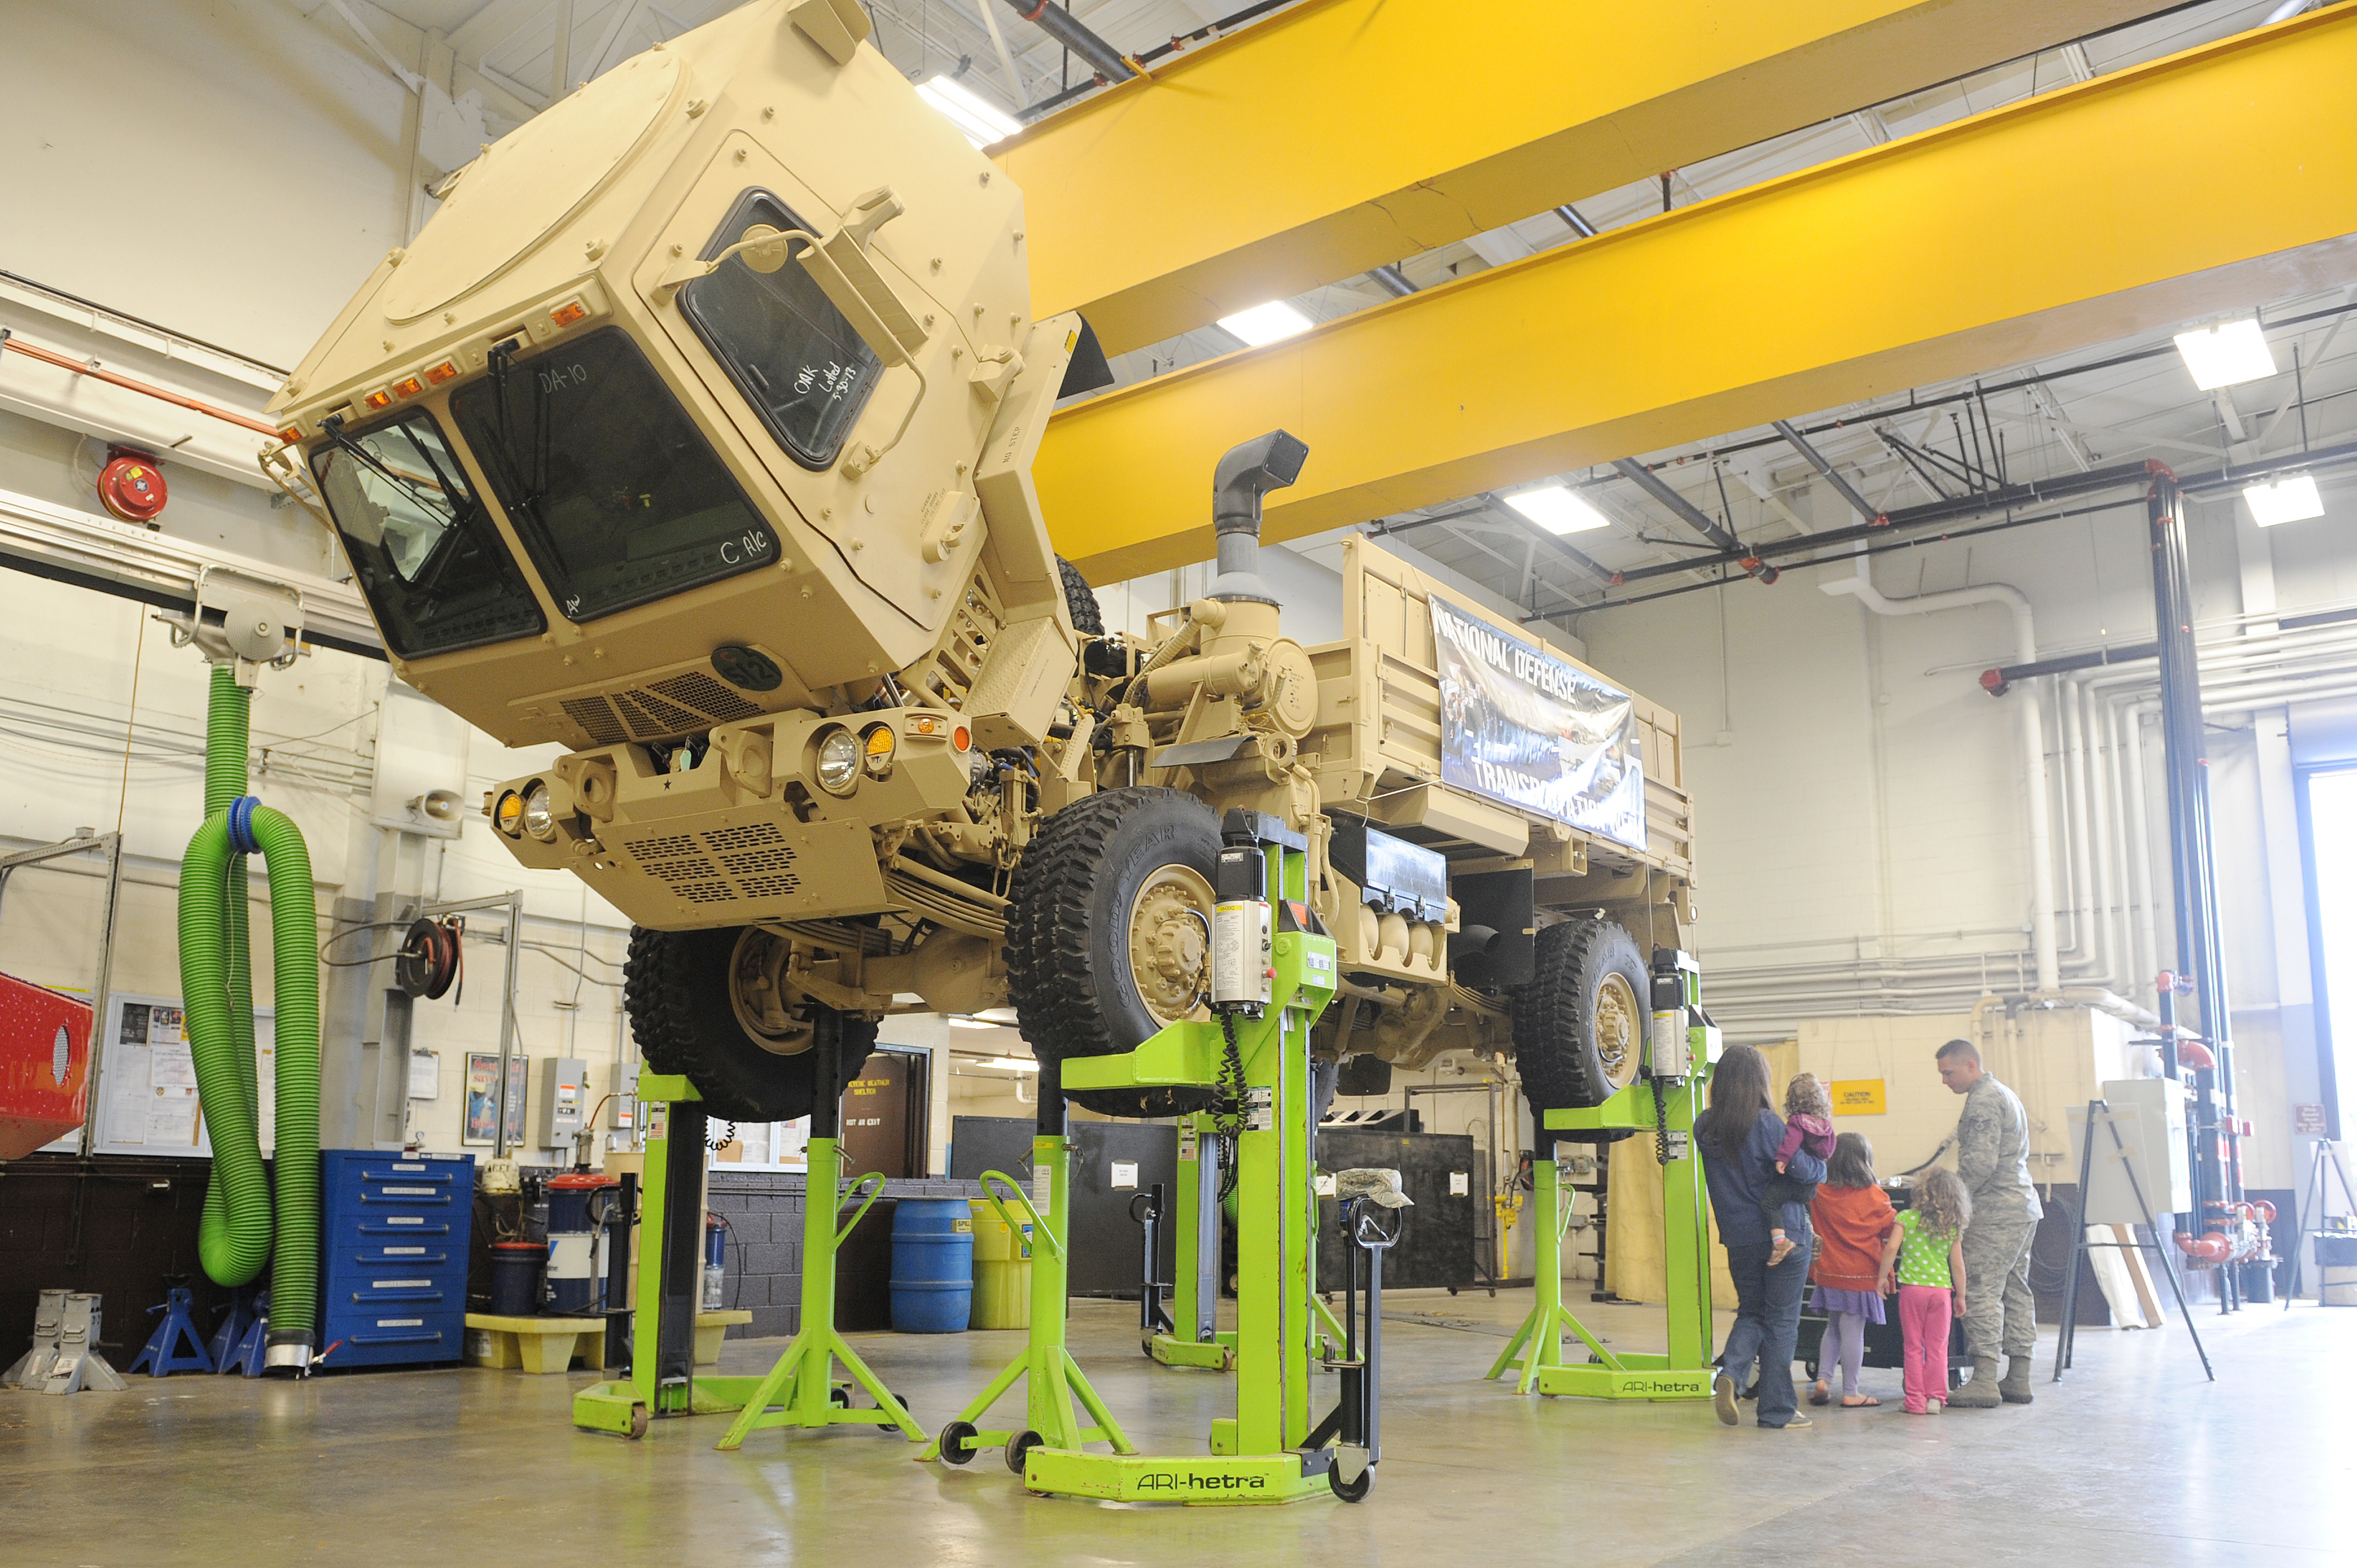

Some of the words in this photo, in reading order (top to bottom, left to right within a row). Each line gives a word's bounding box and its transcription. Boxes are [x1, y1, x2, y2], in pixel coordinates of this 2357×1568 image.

[539, 364, 586, 394] DA-10
[1002, 452, 1012, 463] NO
[1008, 426, 1021, 447] STEP
[1432, 602, 1511, 673] NATIONAL
[1515, 648, 1578, 704] DEFENSE
[866, 1117, 881, 1126] EXIT
[1622, 1381, 1699, 1392] ARI-hetra
[1137, 1473, 1265, 1490] ARI-hetra
